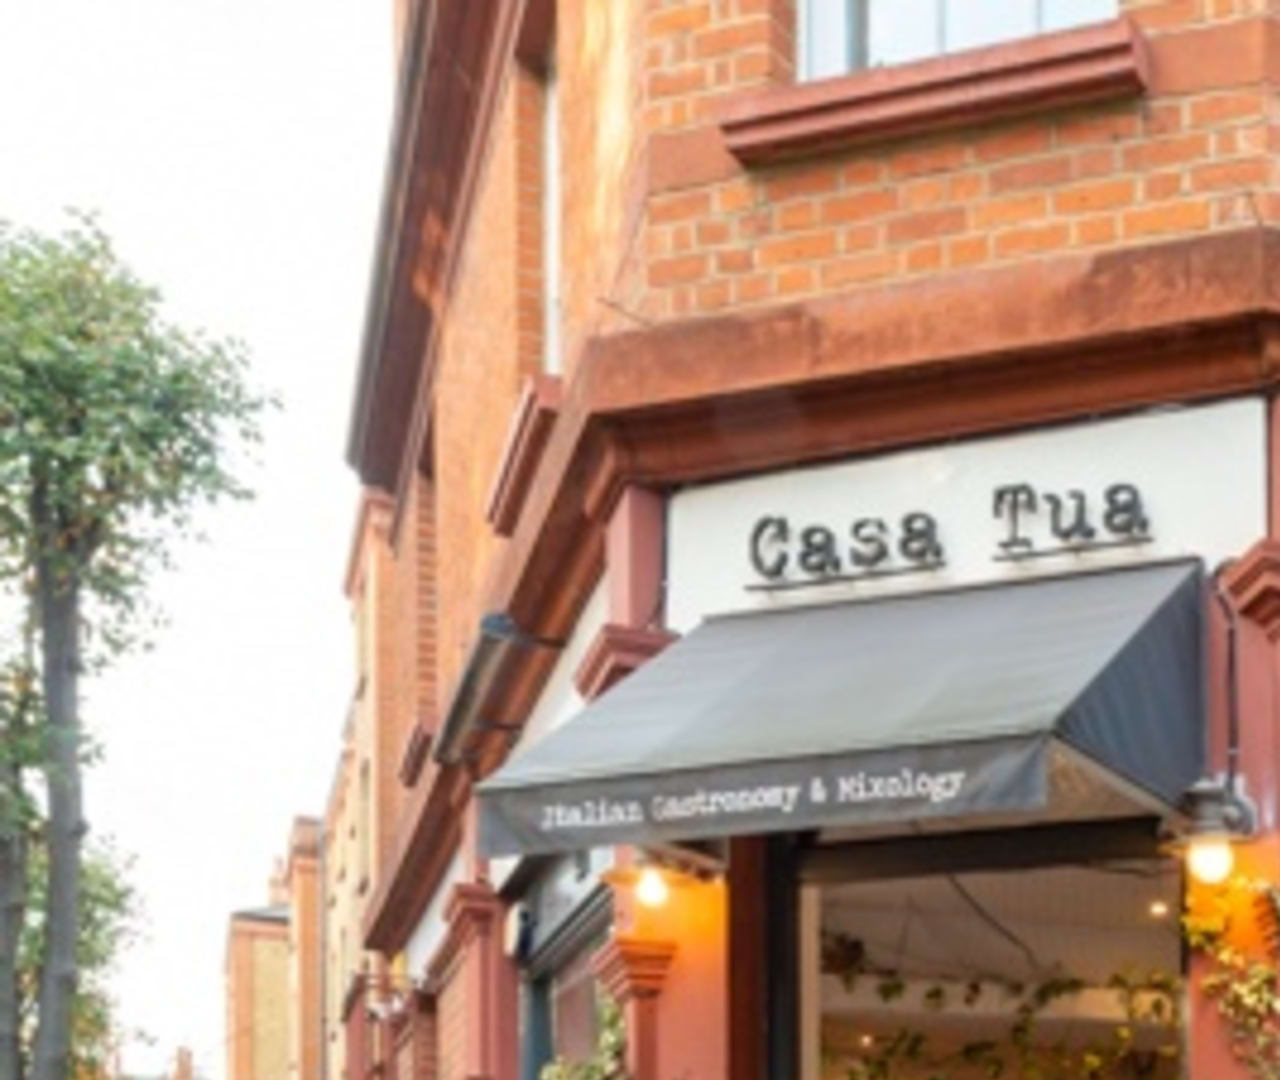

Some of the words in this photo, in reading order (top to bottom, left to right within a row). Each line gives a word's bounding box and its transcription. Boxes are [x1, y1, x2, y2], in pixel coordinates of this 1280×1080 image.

[750, 511, 945, 580] Casa
[992, 482, 1150, 549] Tua
[540, 796, 645, 832] Italian
[652, 785, 800, 822] Gastronomy
[811, 775, 828, 803] &
[837, 766, 966, 803] Mixology
